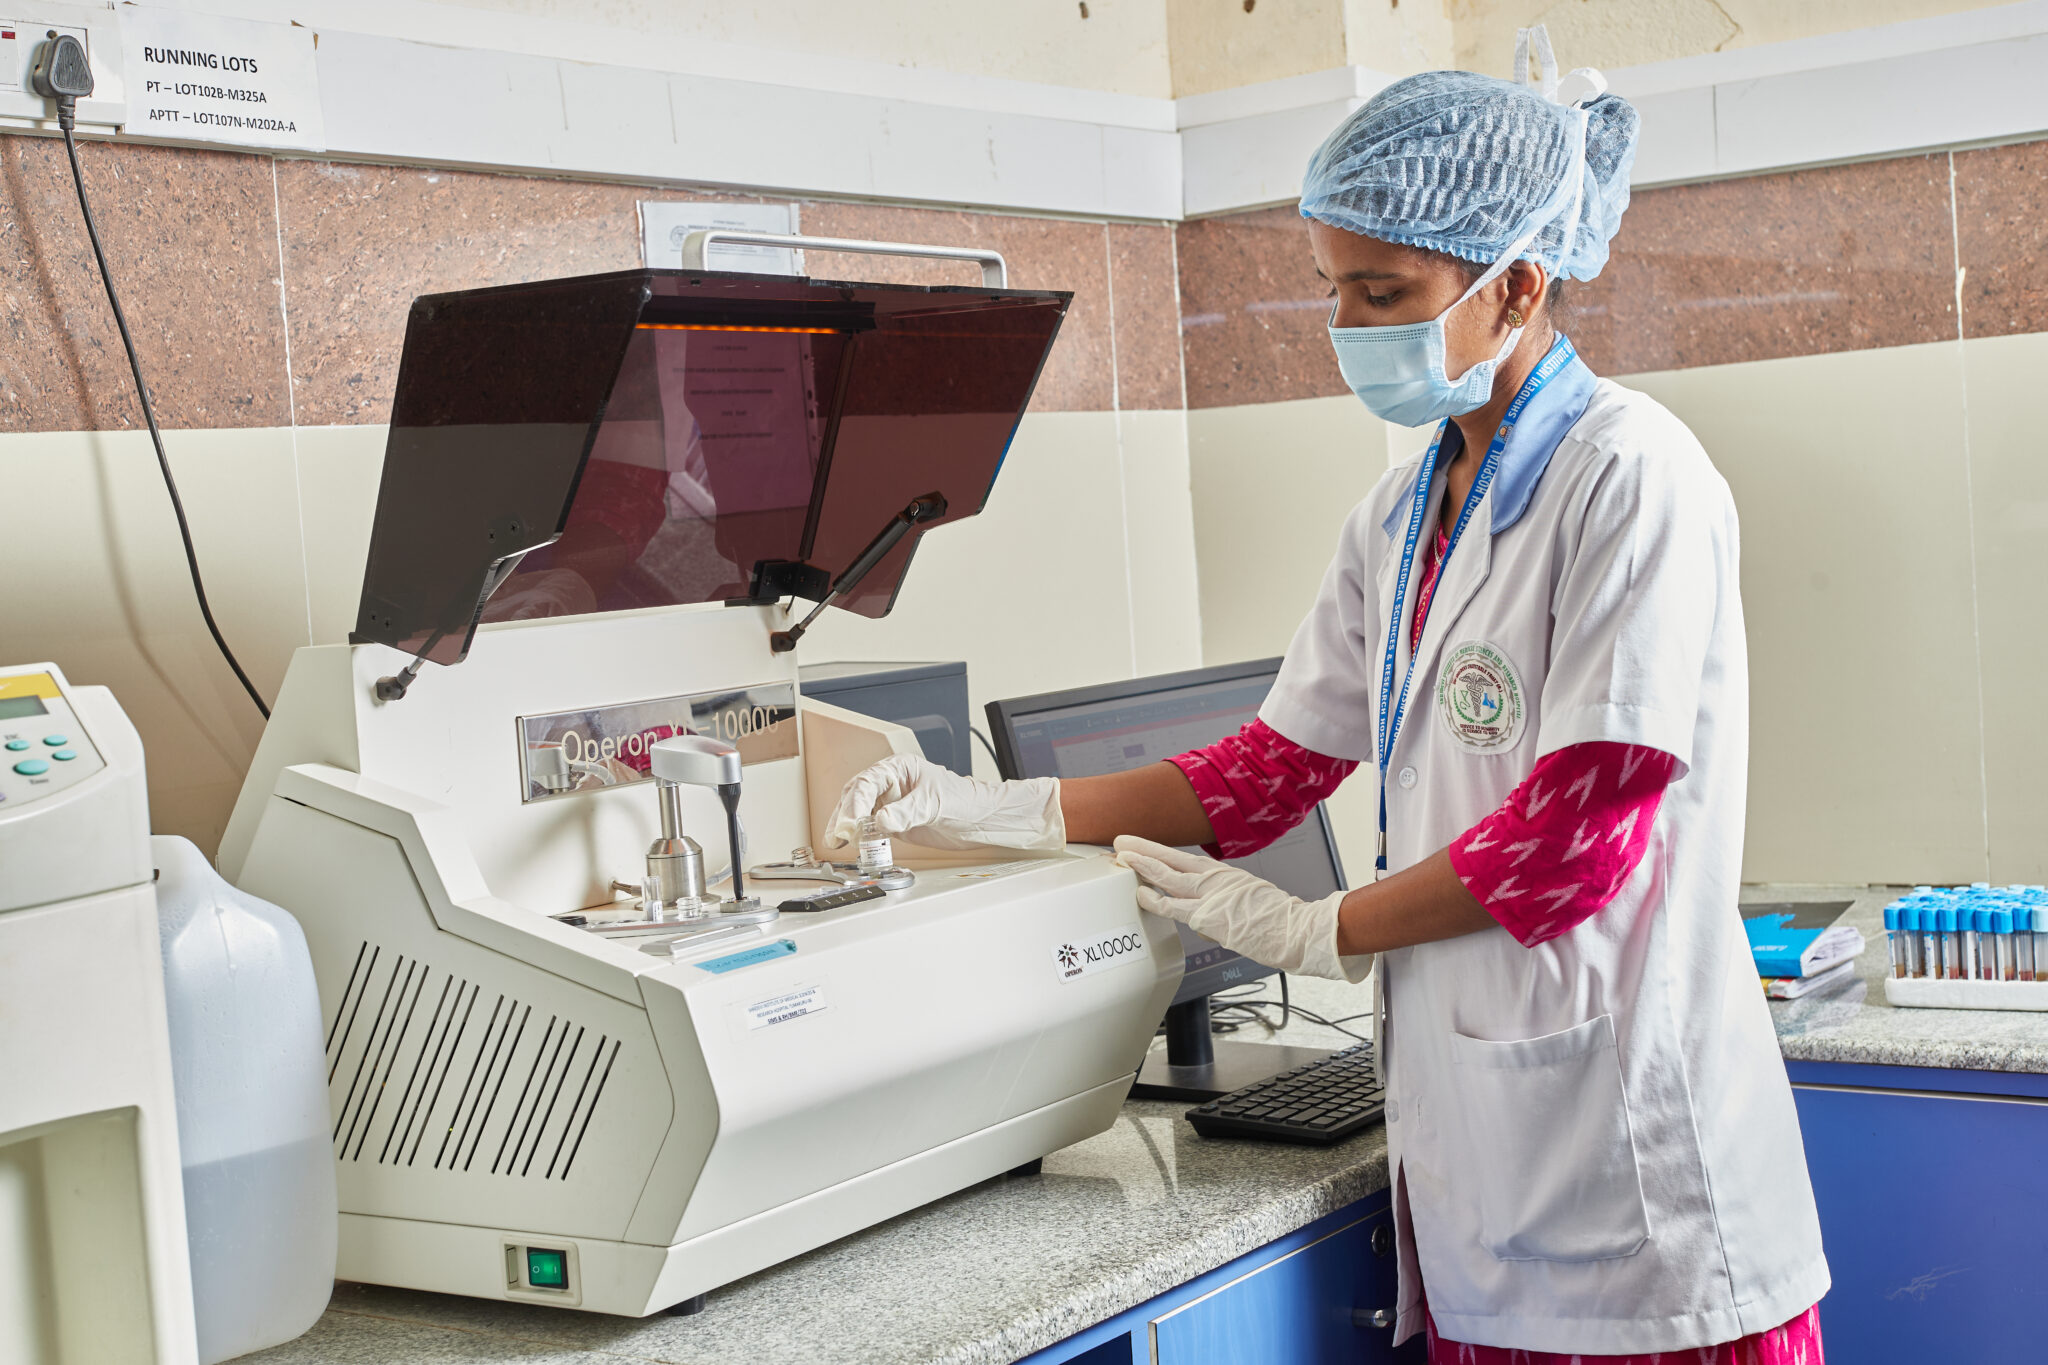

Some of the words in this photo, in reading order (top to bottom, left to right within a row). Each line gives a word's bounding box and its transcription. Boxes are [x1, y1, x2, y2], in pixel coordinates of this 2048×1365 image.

[144, 46, 218, 69] RUNNING
[222, 55, 258, 73] LOTS
[146, 80, 160, 93] PT
[175, 83, 267, 103] LOT102B-M325A
[149, 108, 180, 122] APTT
[193, 112, 297, 132] LOT107N-M202A-A
[1508, 376, 1542, 418] SHRIDEVI
[1536, 347, 1569, 380] INSTITUTE
[1418, 449, 1436, 492] SHRIDEVI
[1475, 449, 1502, 494] HOSPITAL
[1408, 494, 1425, 540] INSTITUTE
[1404, 543, 1413, 556] OF
[1396, 558, 1410, 601] MEDICAL
[1388, 604, 1401, 650] SCIENCES
[1381, 664, 1392, 715] RESEARCH
[561, 730, 657, 769] Operon
[1082, 933, 1142, 963] XL1000C
[1064, 967, 1083, 978] OPERON
[1222, 967, 1242, 982] DELL
